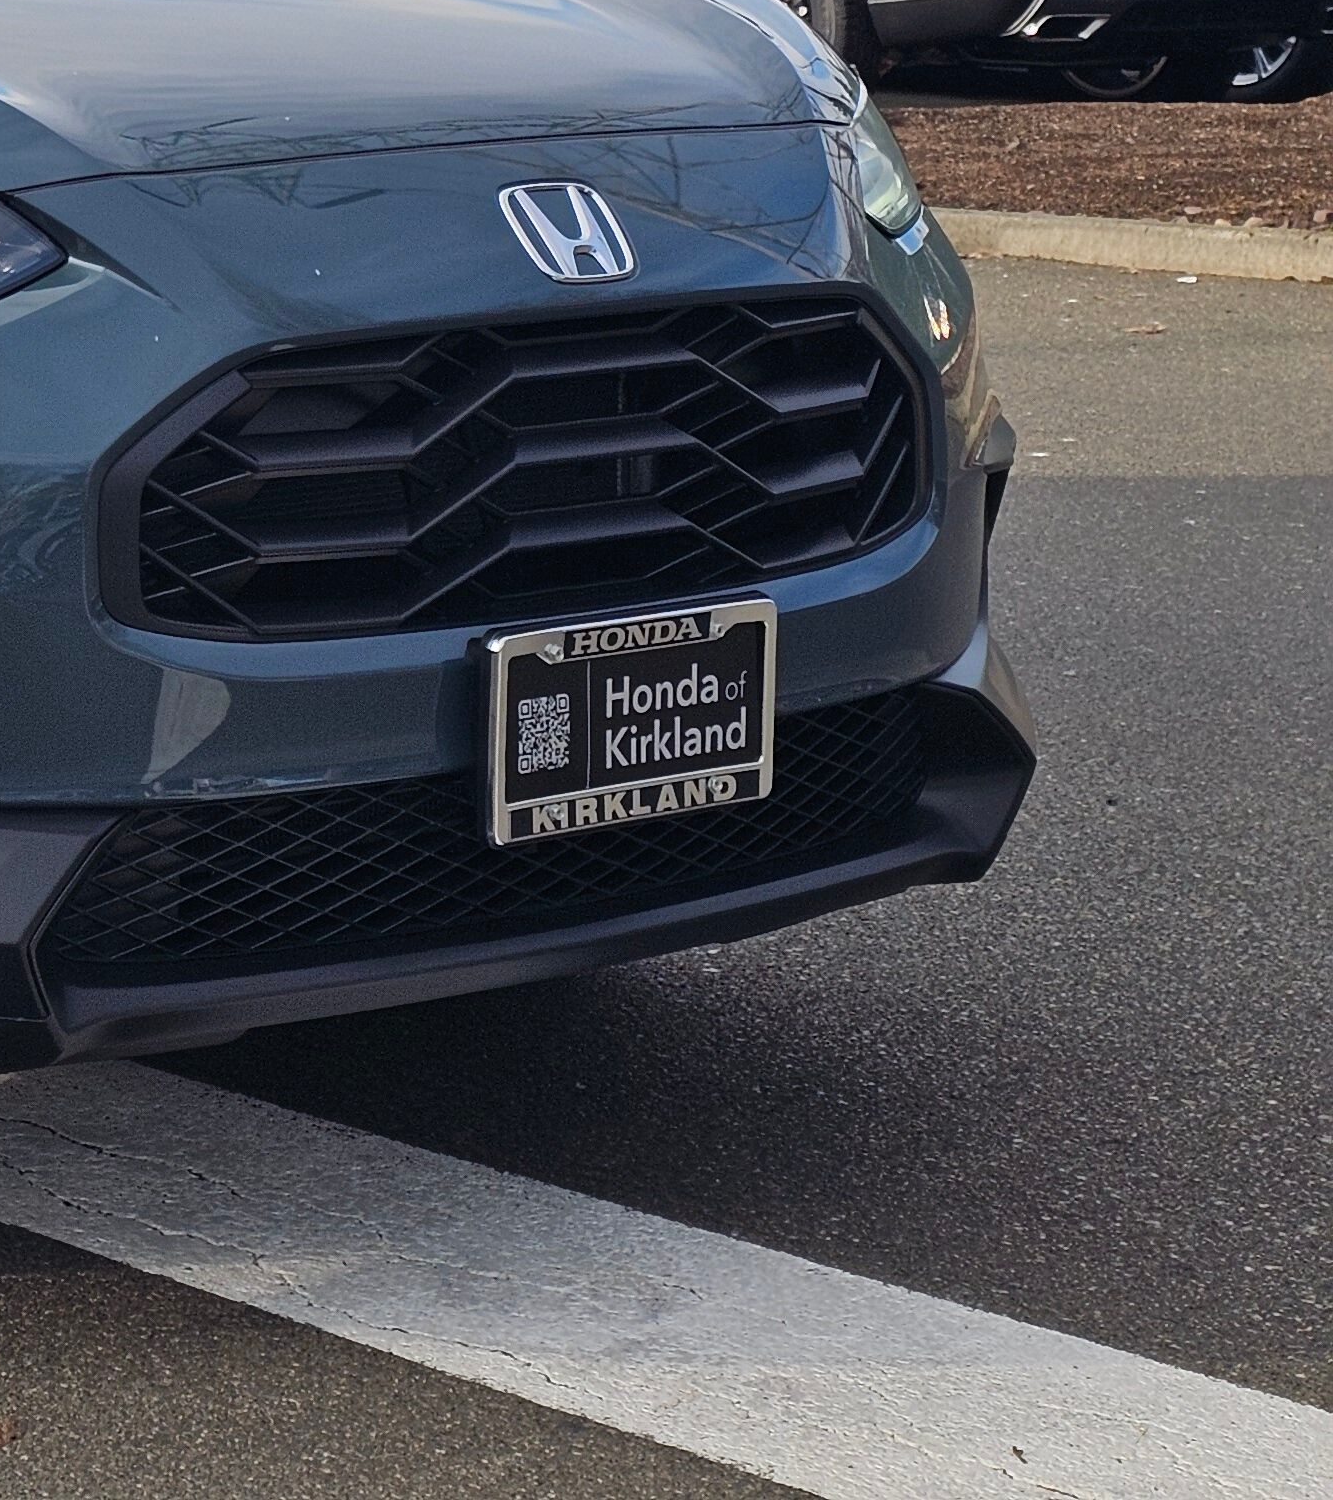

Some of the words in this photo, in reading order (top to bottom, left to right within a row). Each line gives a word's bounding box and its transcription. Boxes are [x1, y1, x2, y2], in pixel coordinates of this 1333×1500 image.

[571, 617, 702, 655] HONDA
[605, 663, 719, 718] Honda
[725, 670, 748, 700] of
[605, 706, 747, 769] Kirkland
[533, 774, 737, 834] KIRKLAND
